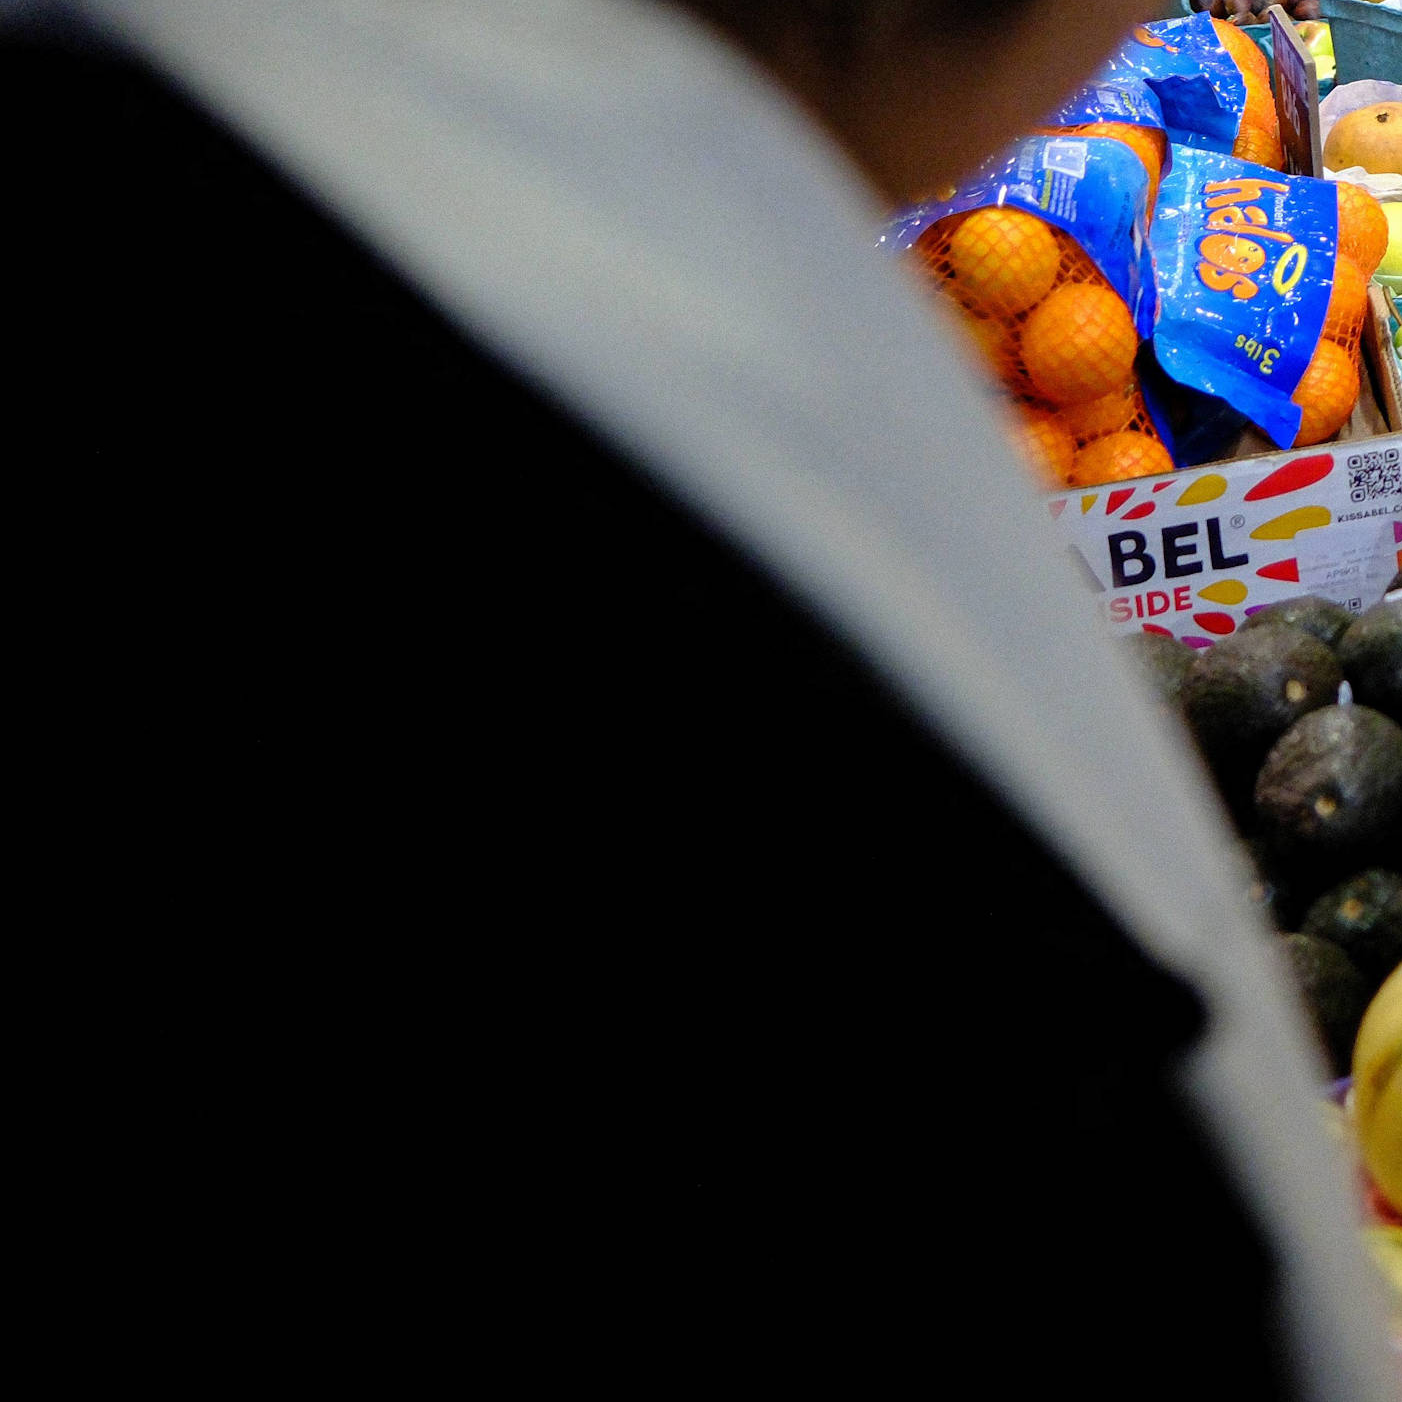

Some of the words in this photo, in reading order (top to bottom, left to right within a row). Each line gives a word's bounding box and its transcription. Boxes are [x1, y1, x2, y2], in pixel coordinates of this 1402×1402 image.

[1199, 178, 1295, 300] halos
[1234, 333, 1262, 361] lbs
[1259, 346, 1281, 375] 3
[1109, 585, 1193, 623] SIDE
